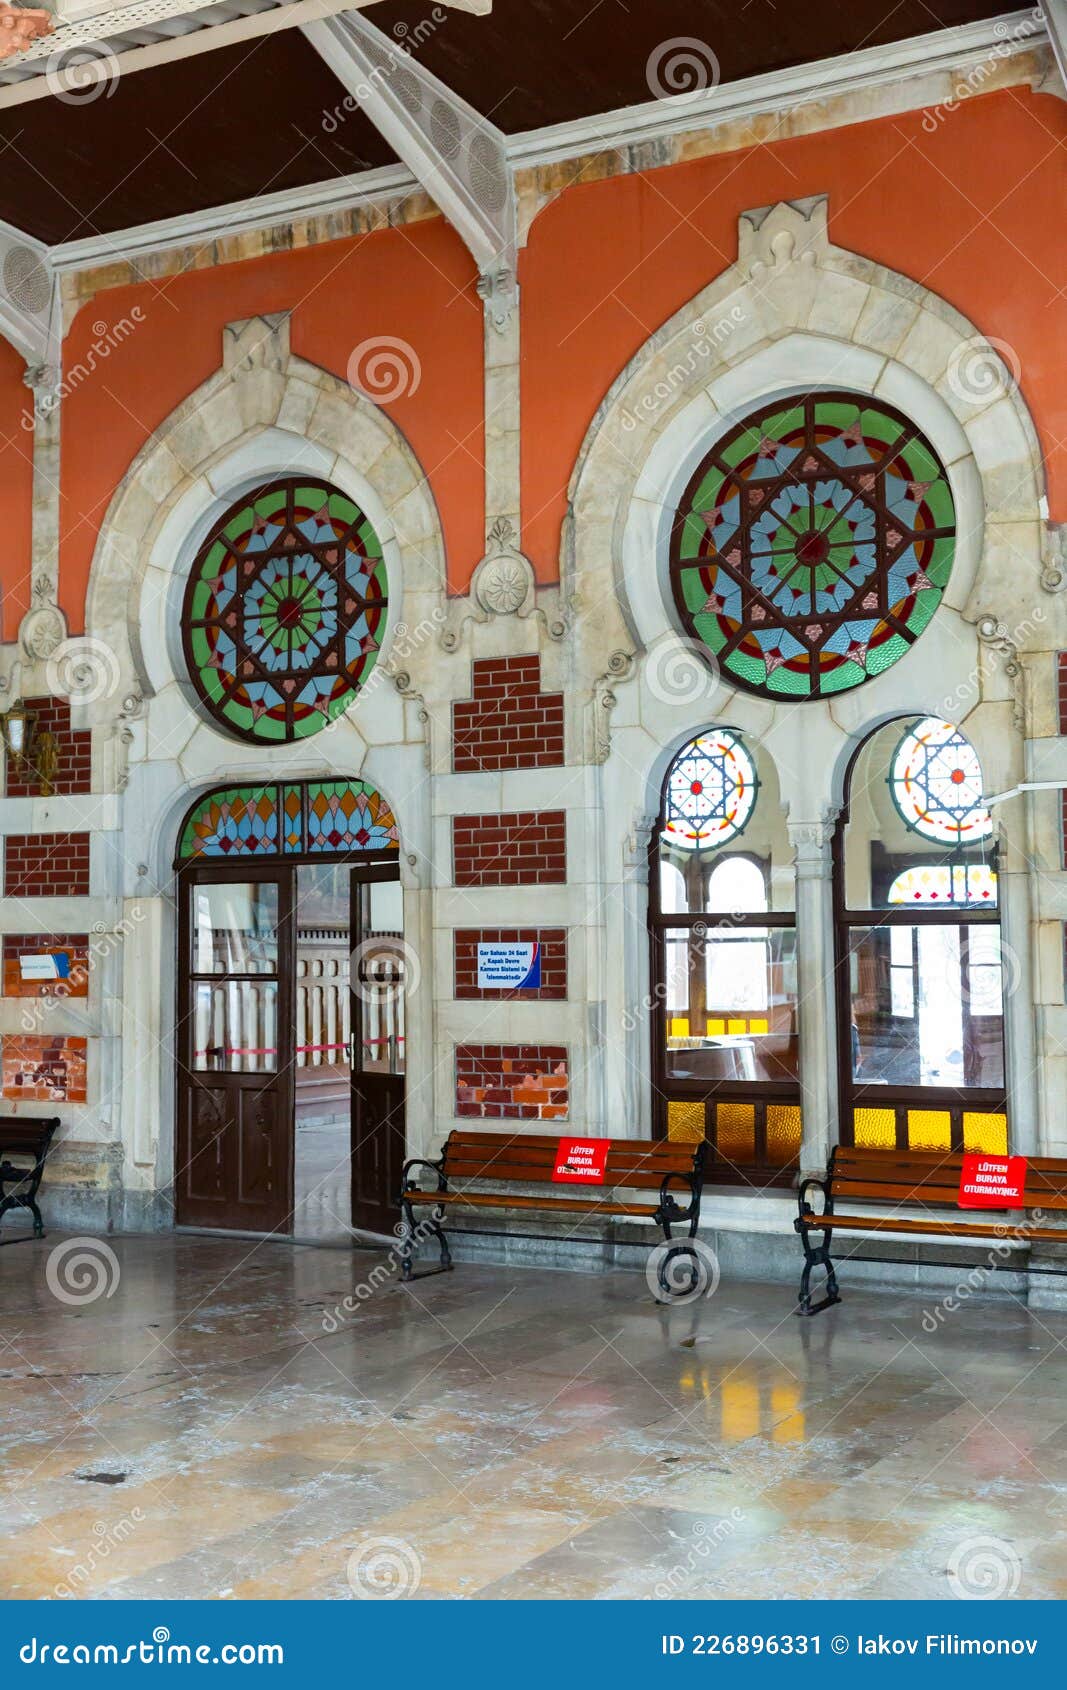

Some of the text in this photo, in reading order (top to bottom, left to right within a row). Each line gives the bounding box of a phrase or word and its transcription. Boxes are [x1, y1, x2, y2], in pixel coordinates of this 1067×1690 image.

[570, 1146, 594, 1155] LÜTFEN
[567, 1156, 592, 1165] BURAYA
[978, 1162, 1008, 1172] LÜTFEN
[976, 1174, 1007, 1184] BURAYA
